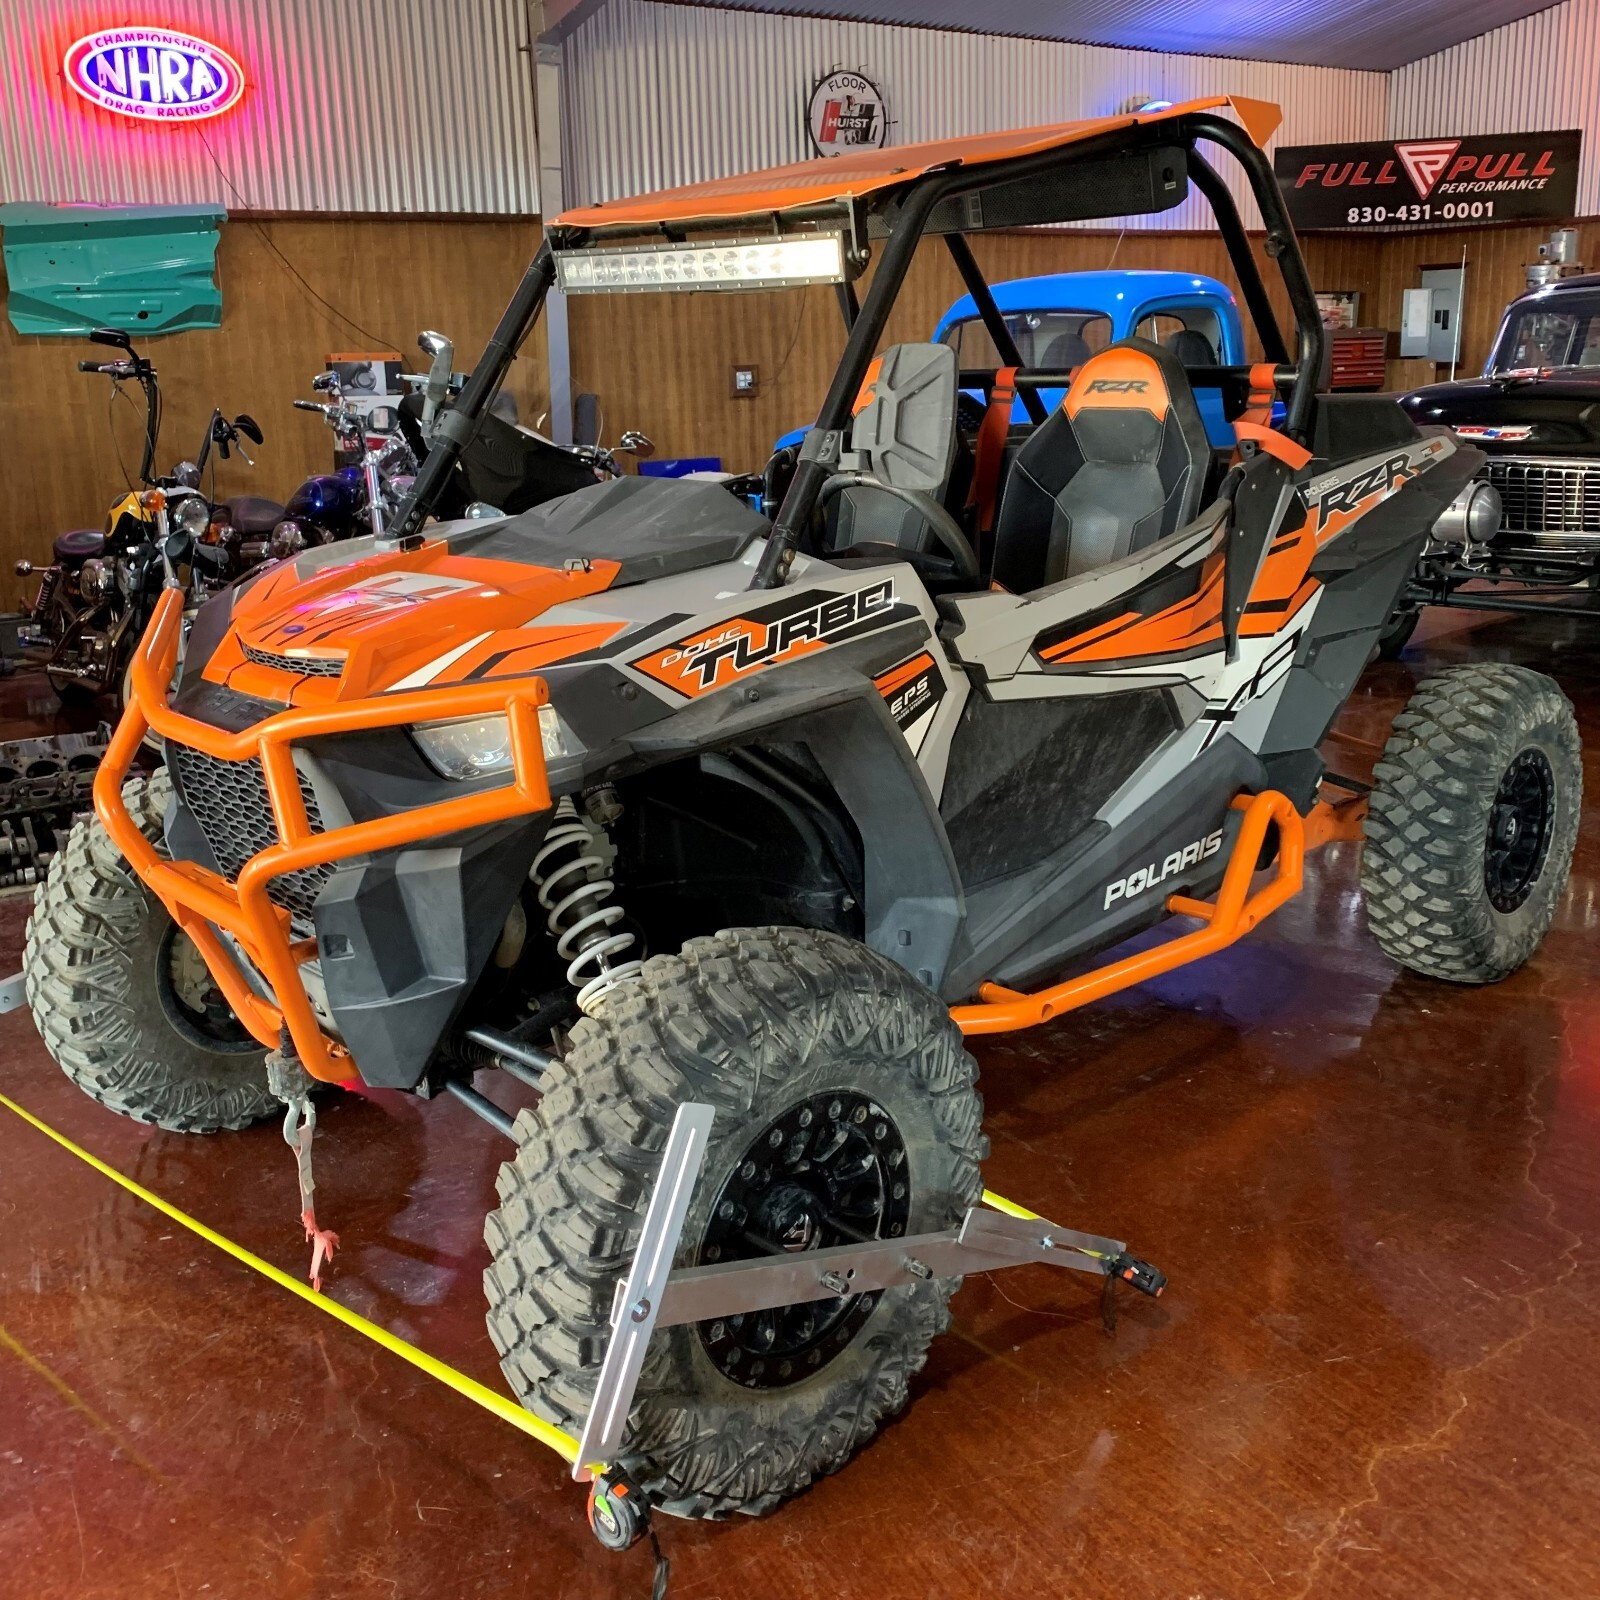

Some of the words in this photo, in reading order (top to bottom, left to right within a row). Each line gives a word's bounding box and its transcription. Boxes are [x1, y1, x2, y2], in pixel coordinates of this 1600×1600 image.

[95, 32, 206, 54] CHAMPIONSHIP
[95, 47, 217, 104] NHRA
[828, 76, 867, 94] FLOOR
[104, 96, 145, 115] DRAG
[157, 103, 211, 118] RACING
[828, 117, 870, 129] HURST
[1295, 160, 1398, 189] FULL
[1446, 151, 1556, 181] PULL
[1438, 177, 1549, 195] PERFORMANCE
[1347, 201, 1495, 224] 830-431-0001
[1083, 379, 1150, 396] RZR
[1303, 475, 1340, 499] POLARIS
[1314, 451, 1419, 536] RZR
[679, 575, 895, 691] TURBO
[660, 625, 743, 669] DOHC
[890, 675, 929, 716] EPS
[1103, 828, 1224, 911] POLARIS
